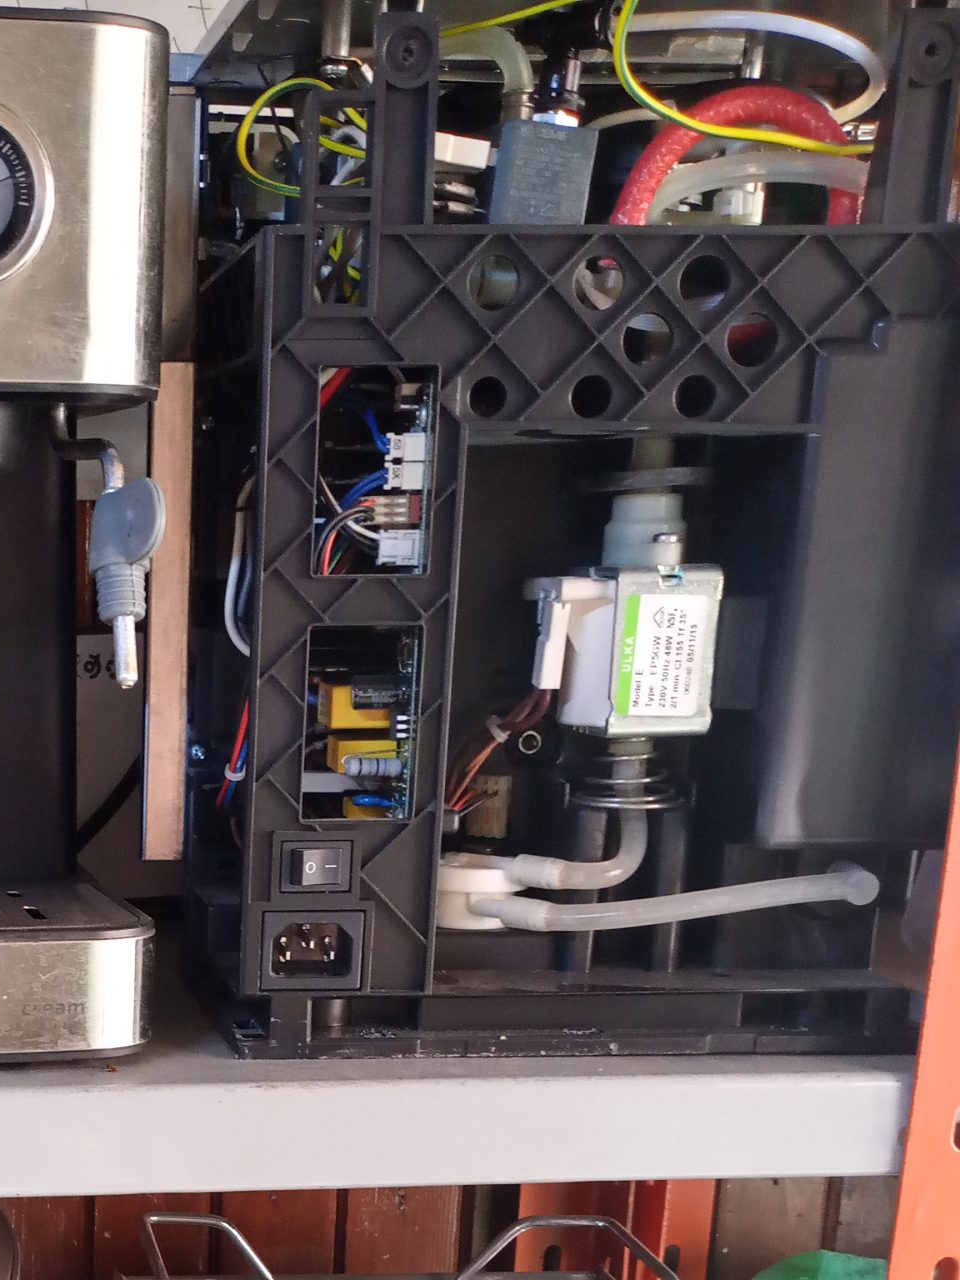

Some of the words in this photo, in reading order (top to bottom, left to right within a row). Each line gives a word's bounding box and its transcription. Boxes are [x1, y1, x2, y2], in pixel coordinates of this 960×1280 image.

[622, 636, 635, 673] ULKA
[632, 680, 642, 708] Model
[645, 685, 655, 707] Type
